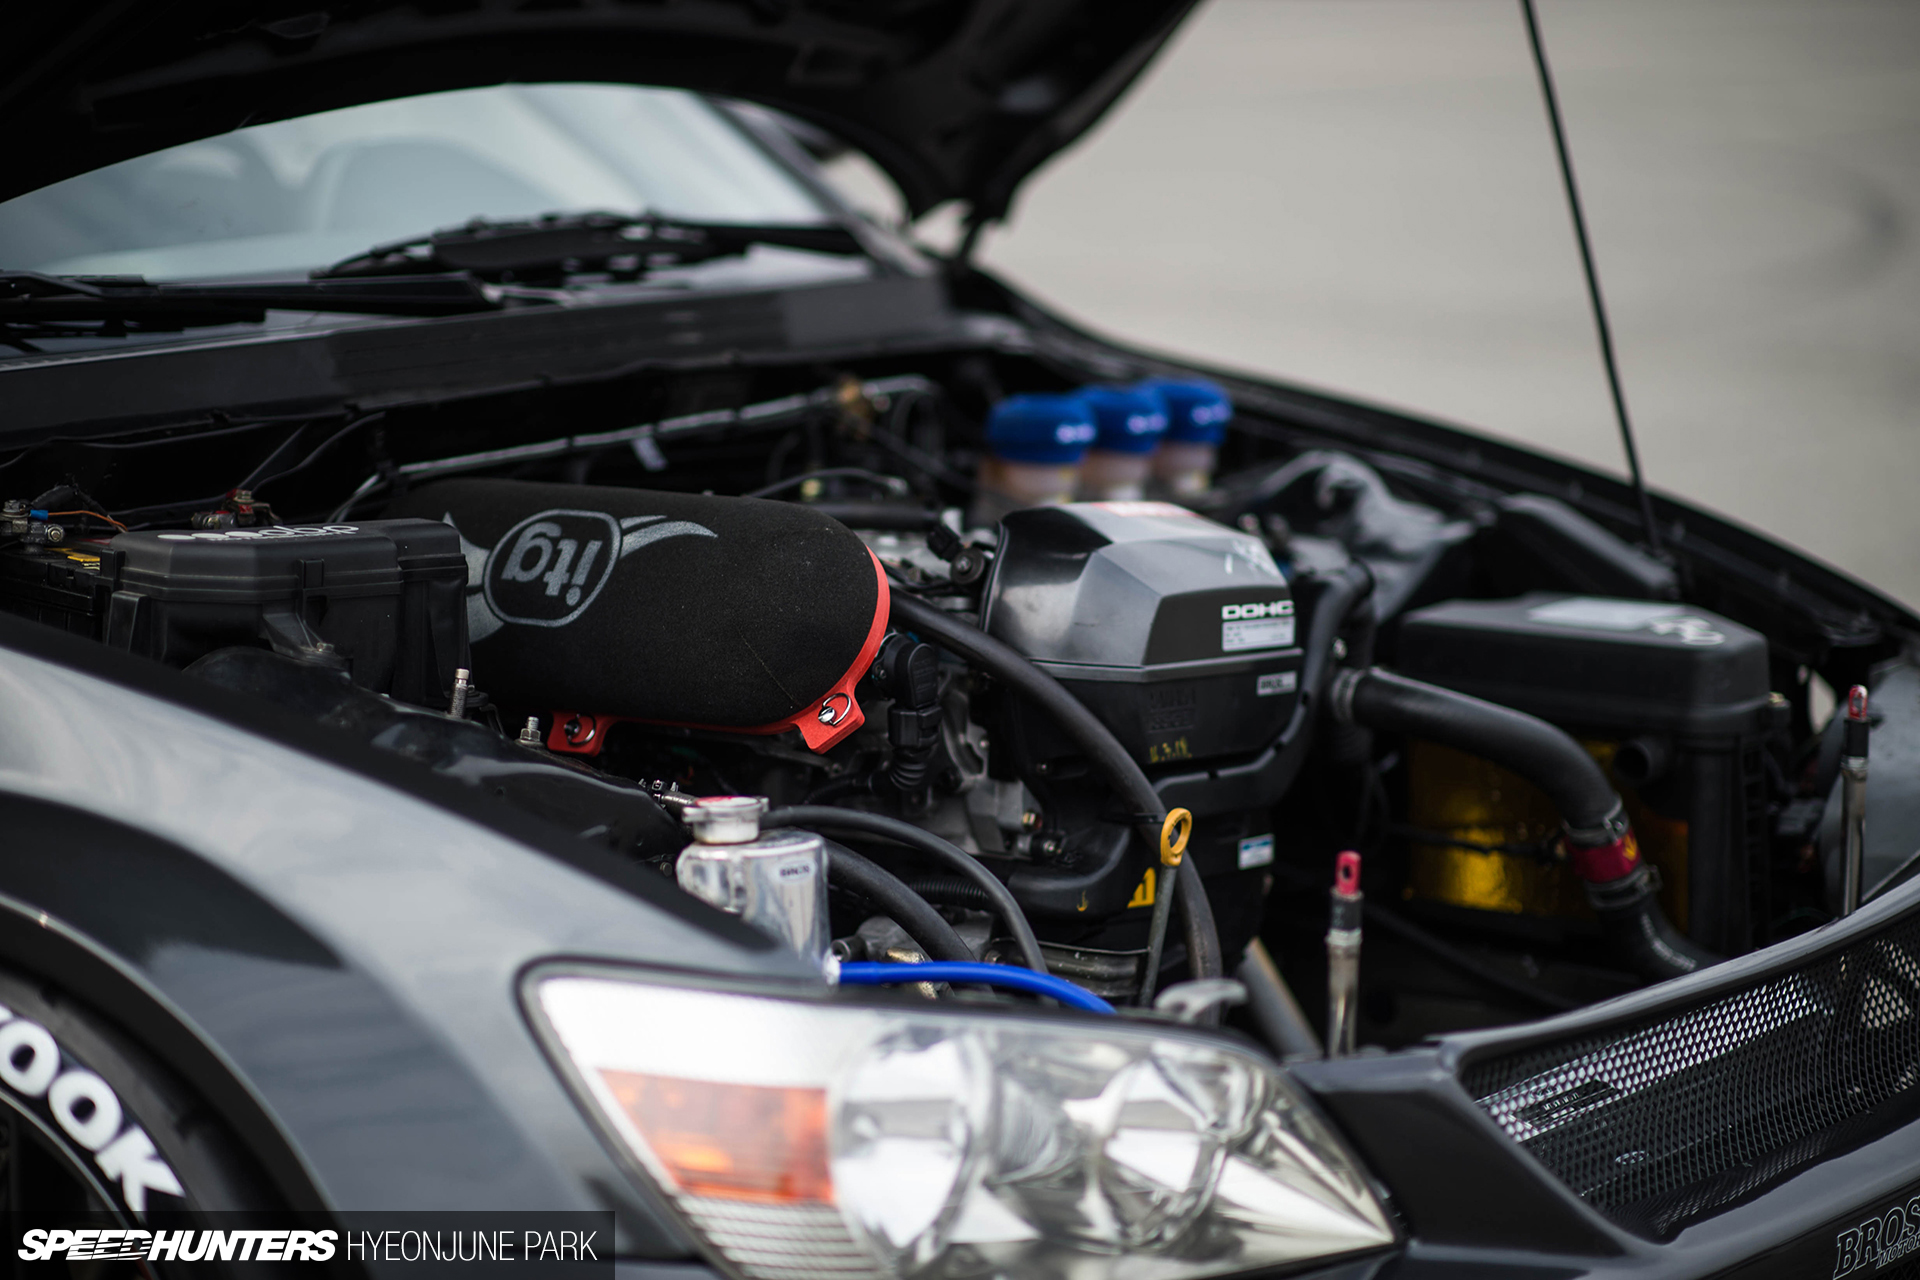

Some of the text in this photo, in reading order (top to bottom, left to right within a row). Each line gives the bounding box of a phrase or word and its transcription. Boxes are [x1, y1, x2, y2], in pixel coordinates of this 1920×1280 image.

[501, 521, 603, 607] itg
[1221, 599, 1295, 620] DOHC
[0, 1003, 187, 1226] OOK
